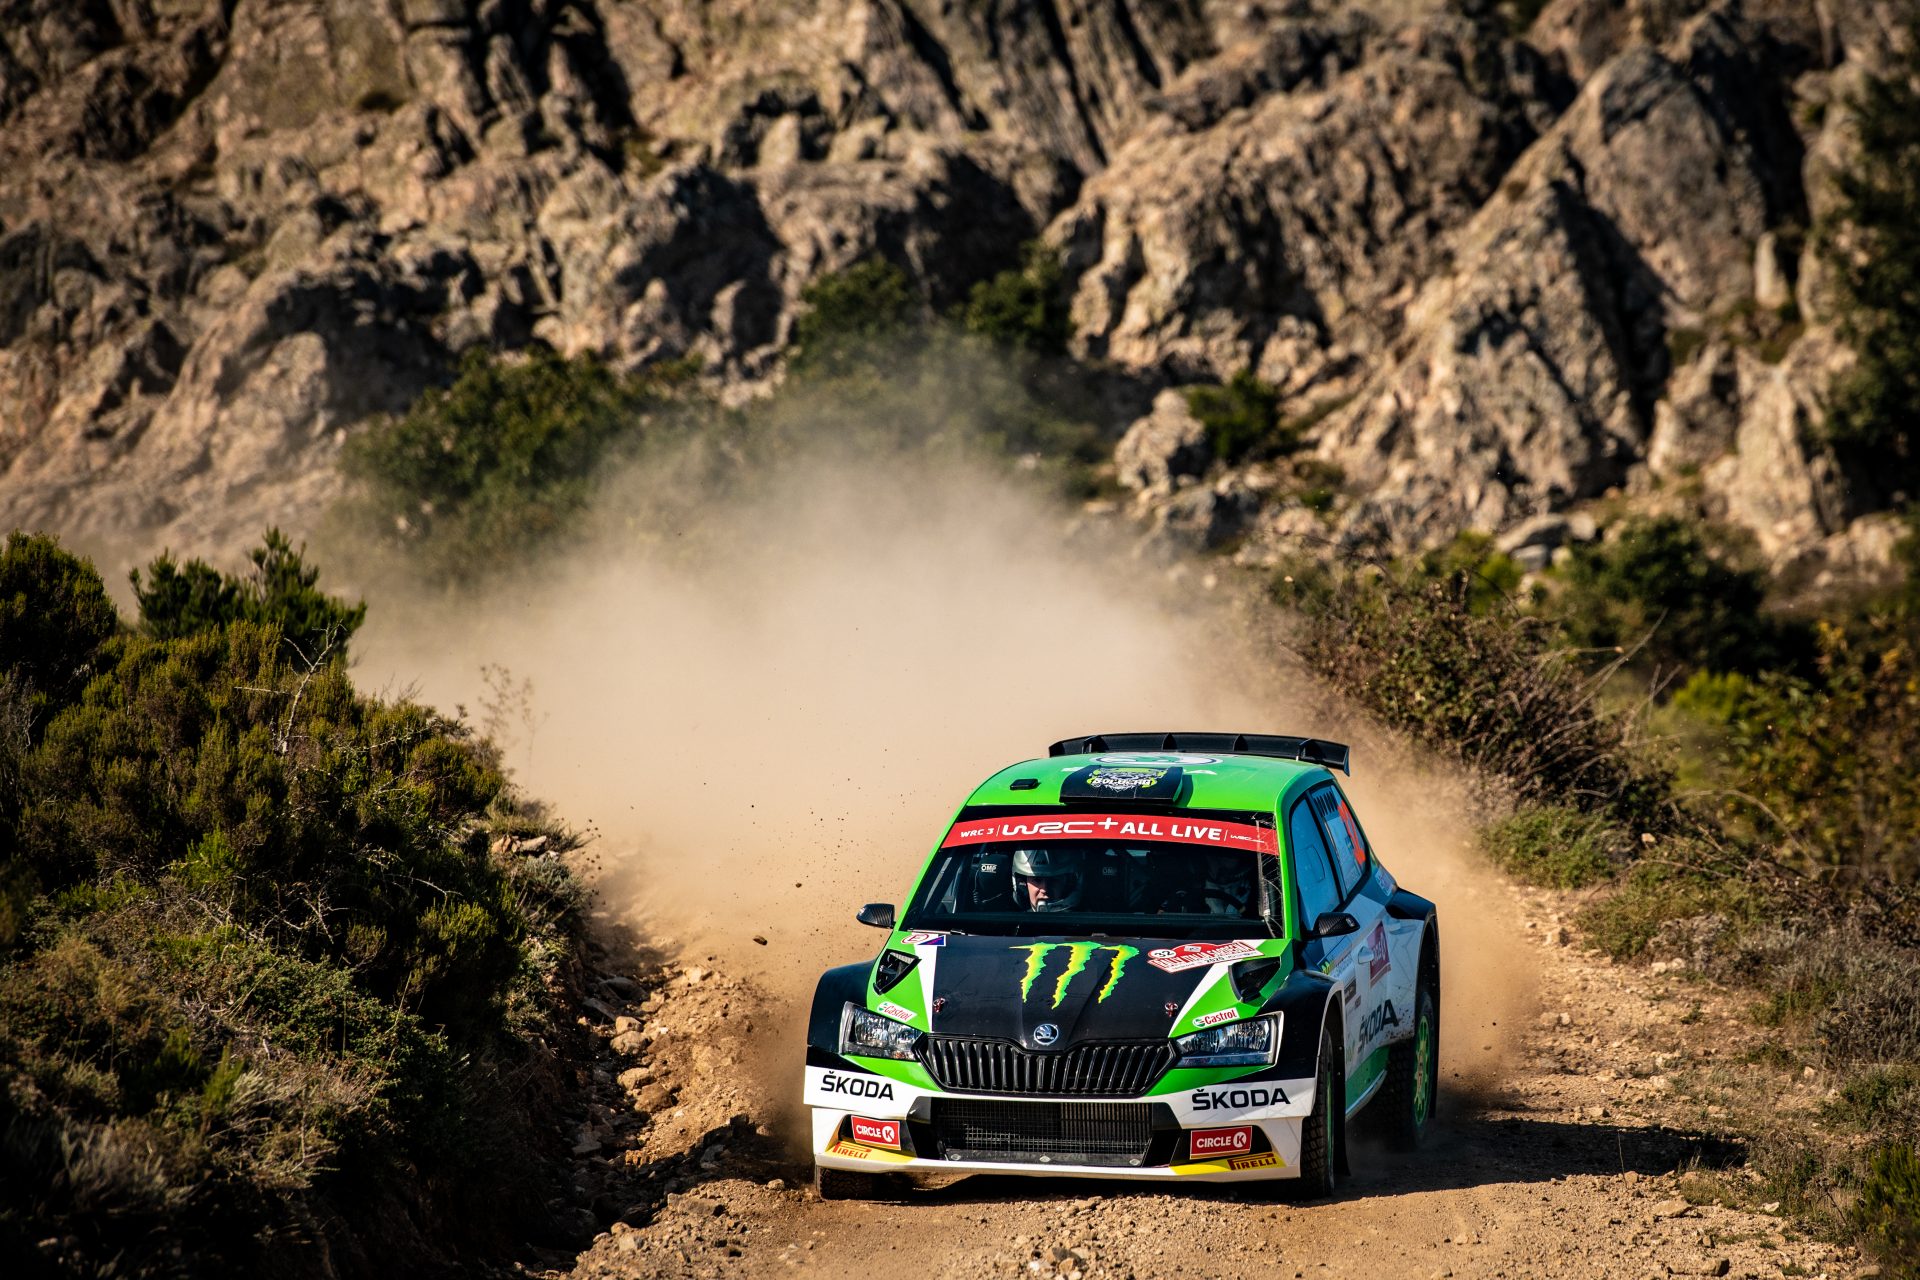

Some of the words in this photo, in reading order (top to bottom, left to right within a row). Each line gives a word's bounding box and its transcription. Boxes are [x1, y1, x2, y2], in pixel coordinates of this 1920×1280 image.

[960, 828, 984, 838] WRC
[986, 827, 994, 835] 3
[1120, 821, 1163, 836] ALL
[1171, 825, 1222, 841] LIVE
[981, 863, 998, 874] OMP
[1154, 950, 1175, 958] 32
[884, 1005, 913, 1020] Castrol
[1204, 1009, 1237, 1025] Castrol
[820, 1070, 894, 1101] ŠKODA
[1191, 1087, 1291, 1111] ŠKODA
[855, 1124, 882, 1138] CIRCLE
[832, 1141, 872, 1159] PIRELLI
[1196, 1136, 1232, 1148] CIRCLE
[1226, 1153, 1278, 1171] PIRELLI
